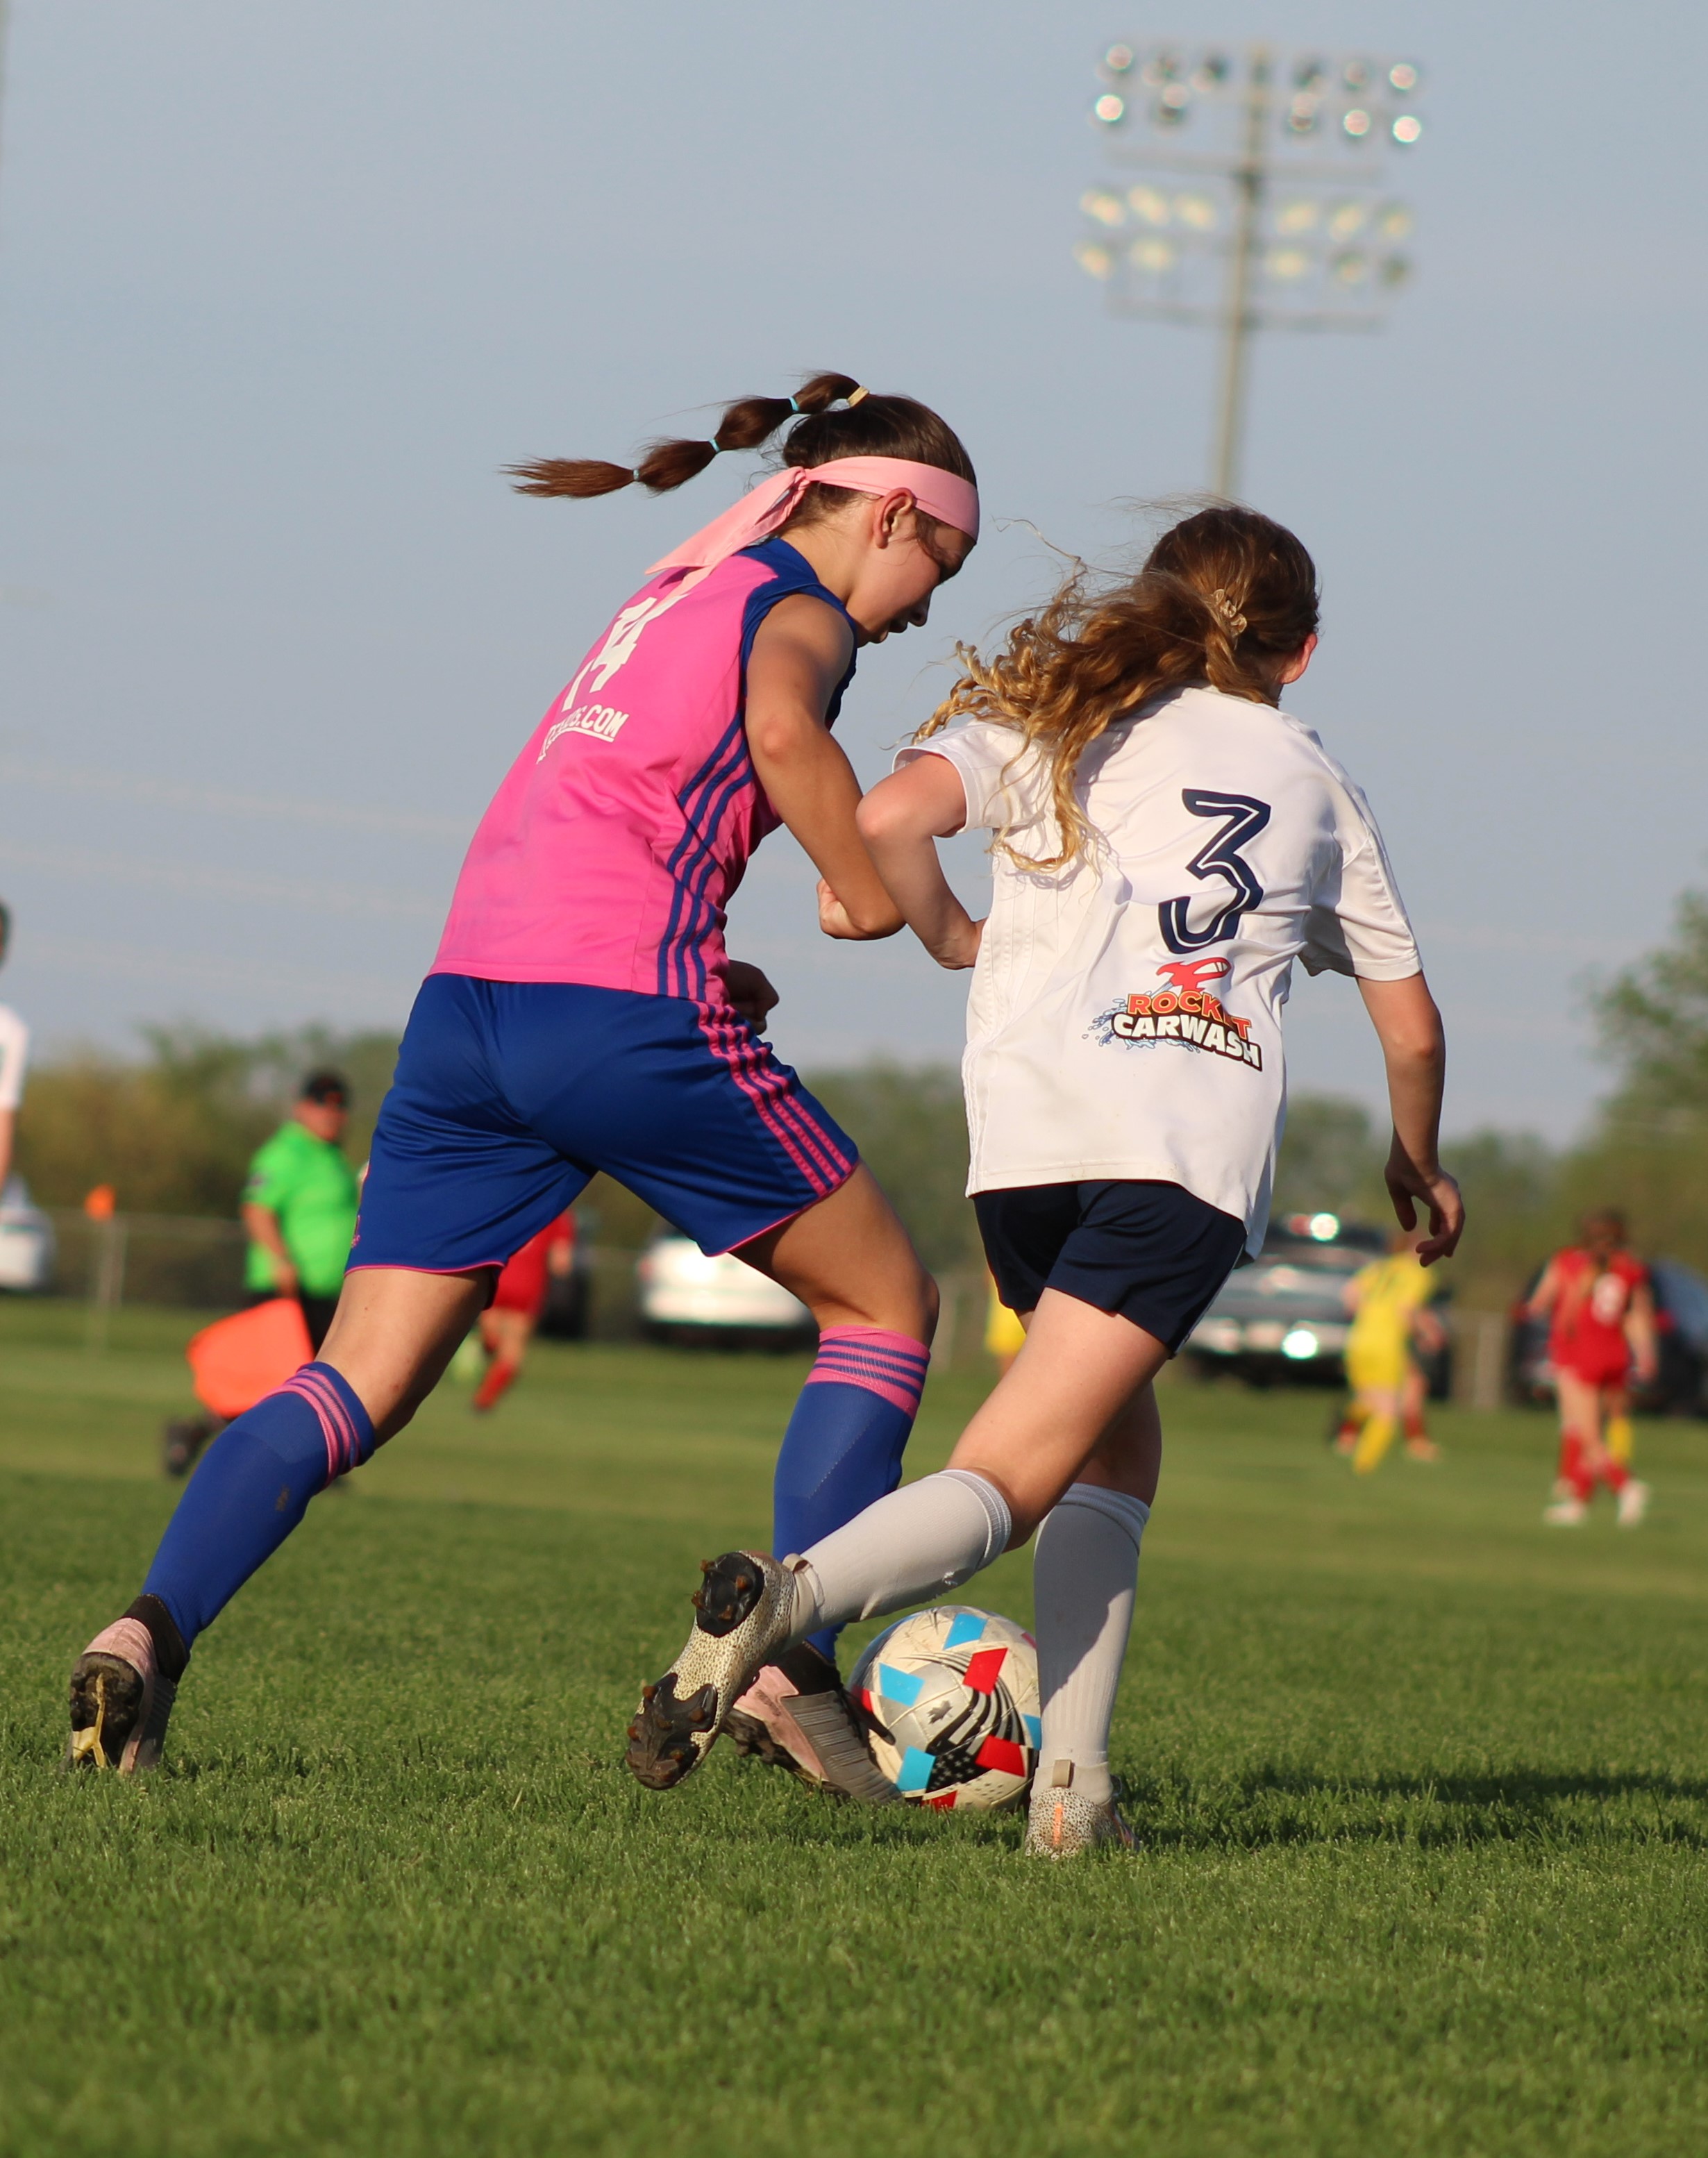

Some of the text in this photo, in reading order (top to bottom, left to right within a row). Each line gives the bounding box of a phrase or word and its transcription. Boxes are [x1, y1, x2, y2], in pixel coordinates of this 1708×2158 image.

[1158, 788, 1271, 955] 3
[1113, 1013, 1262, 1070] CARWASH
[1128, 990, 1252, 1040] ROCKT
